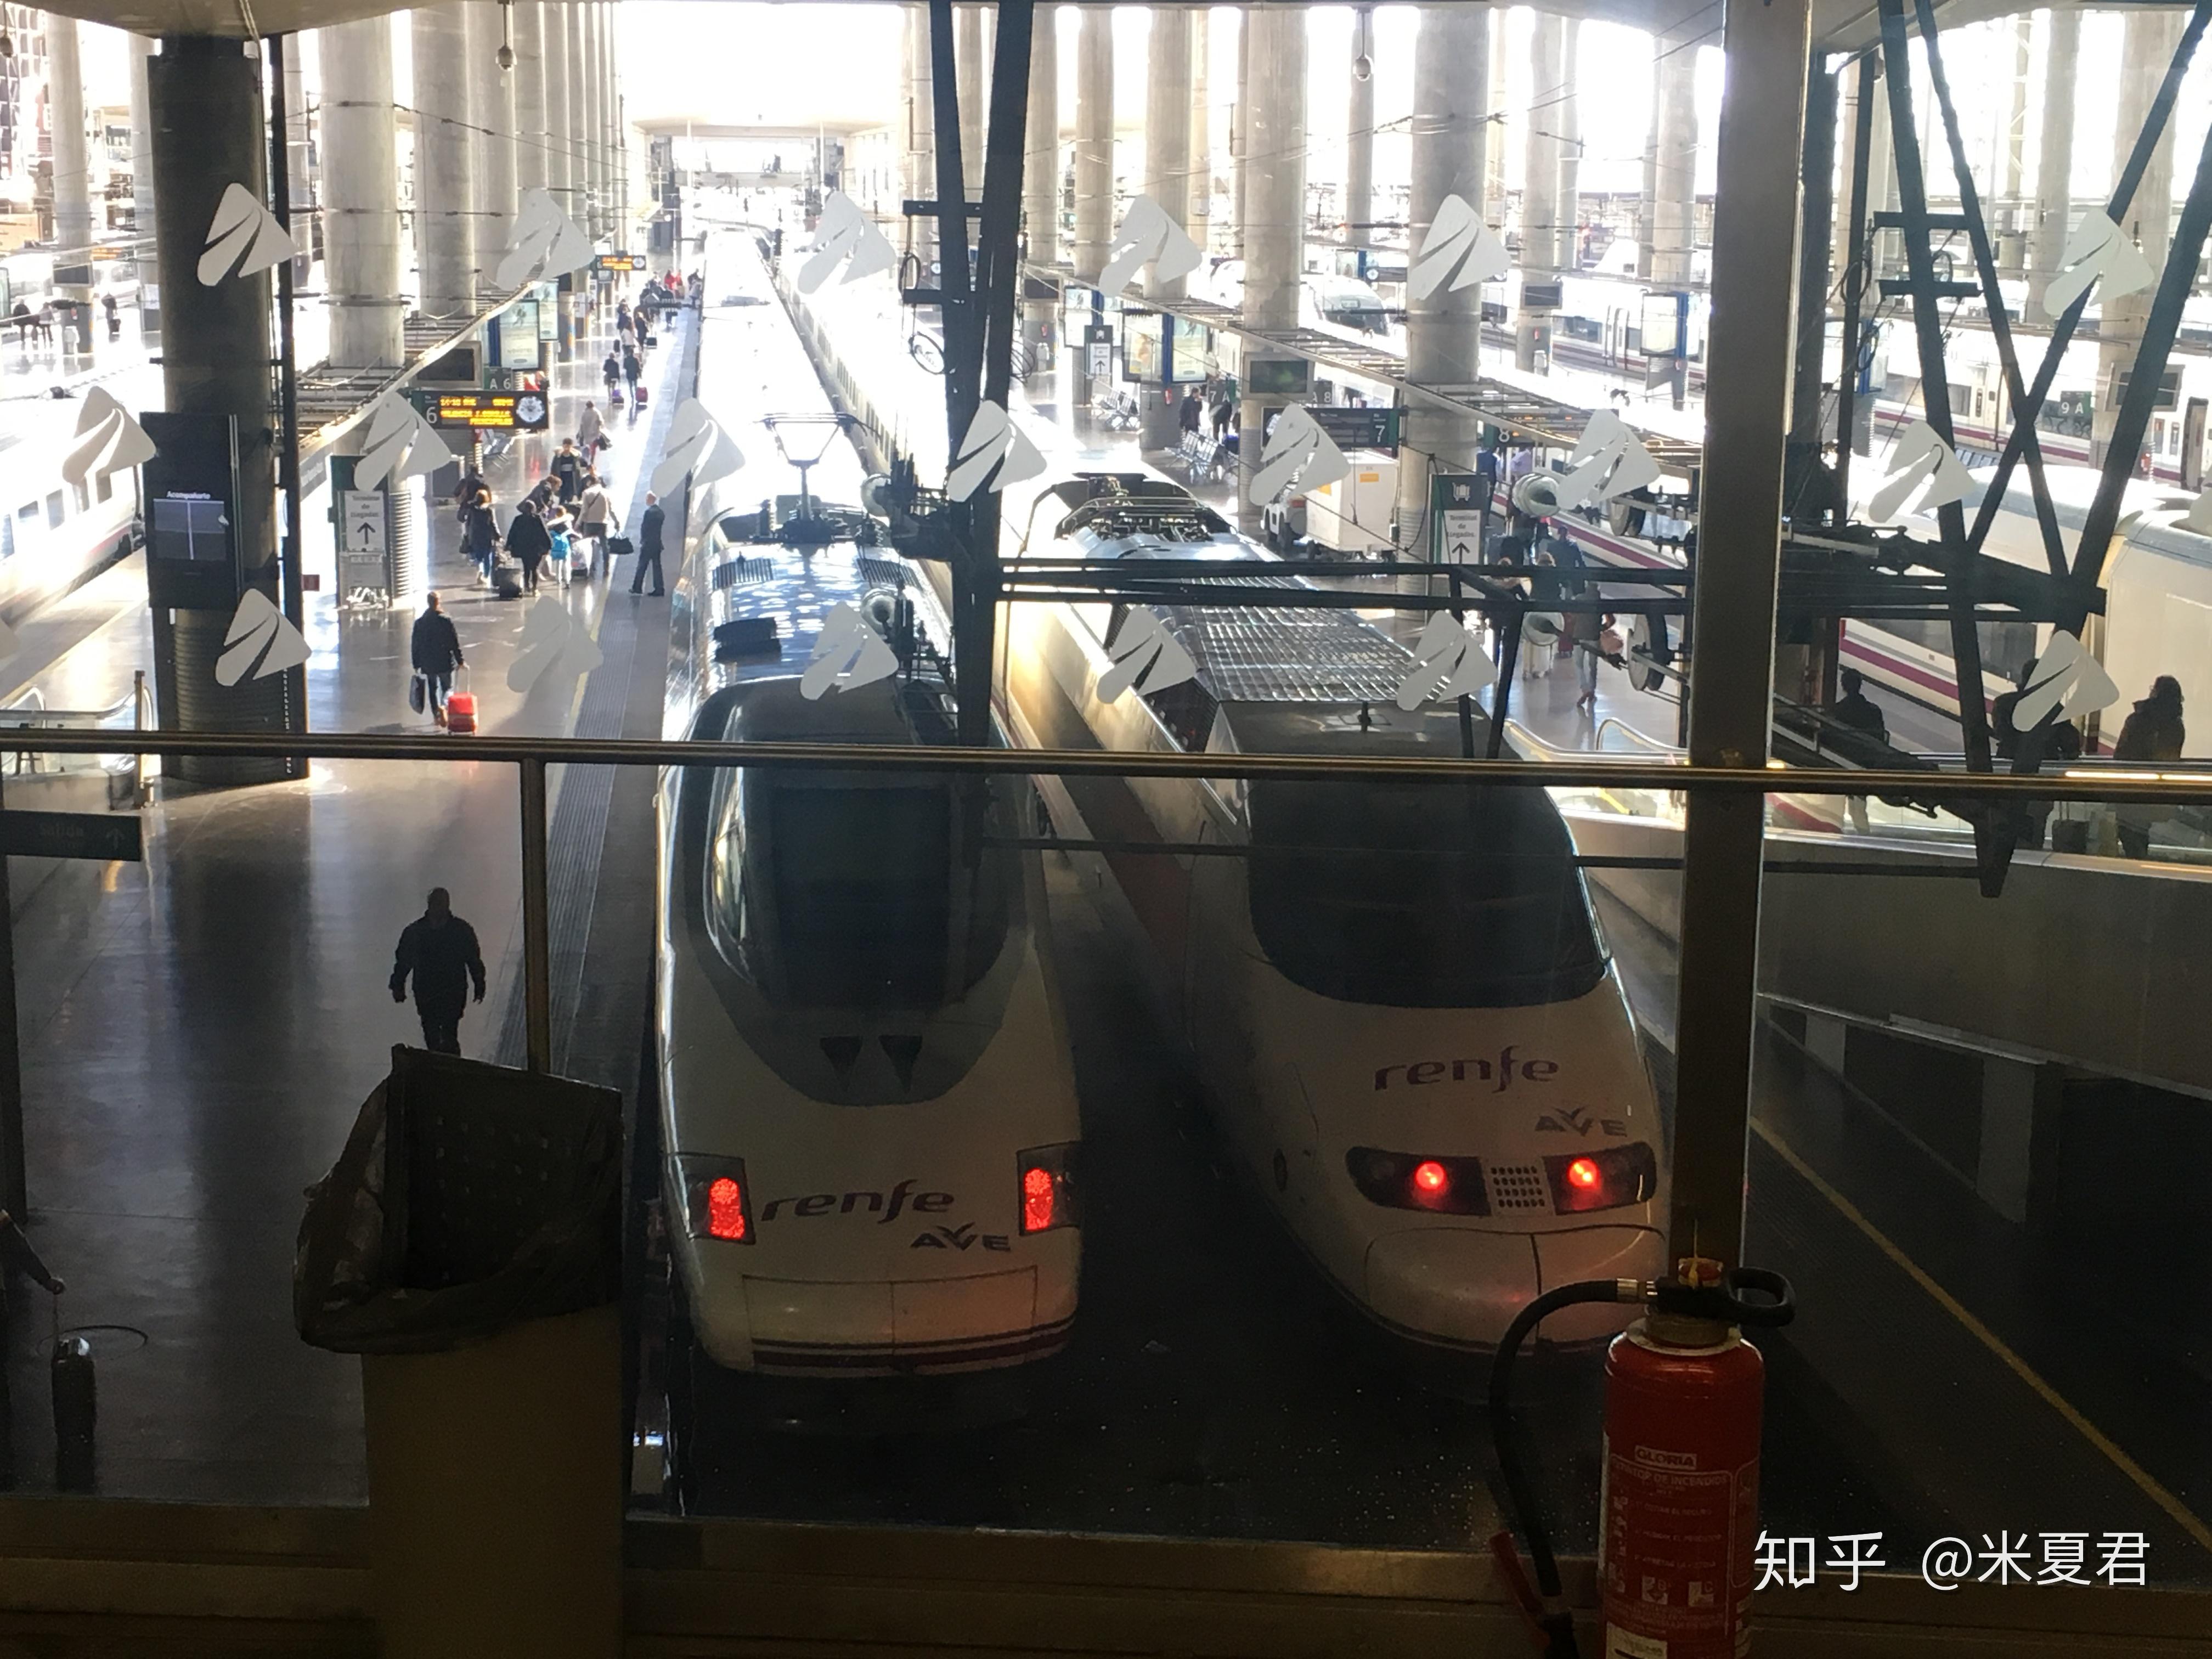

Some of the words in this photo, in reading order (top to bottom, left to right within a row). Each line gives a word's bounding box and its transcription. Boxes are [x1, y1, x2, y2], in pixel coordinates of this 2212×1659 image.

[489, 378, 498, 390] A
[503, 378, 511, 390] 6
[1210, 391, 1217, 403] 7
[1222, 390, 1231, 403] A
[1324, 392, 1331, 403] 8
[426, 406, 438, 424] 6
[2061, 402, 2070, 414] 9
[2074, 402, 2084, 414] A
[1375, 425, 1385, 443] 7
[1498, 428, 1510, 442] 8
[1374, 1045, 1559, 1093] renfe
[1534, 1105, 1629, 1137] AVE
[760, 1179, 955, 1224] renfe
[910, 1221, 1012, 1252] AVE
[1637, 1449, 1695, 1466] GLORIA
[1654, 1473, 1669, 1483] DE
